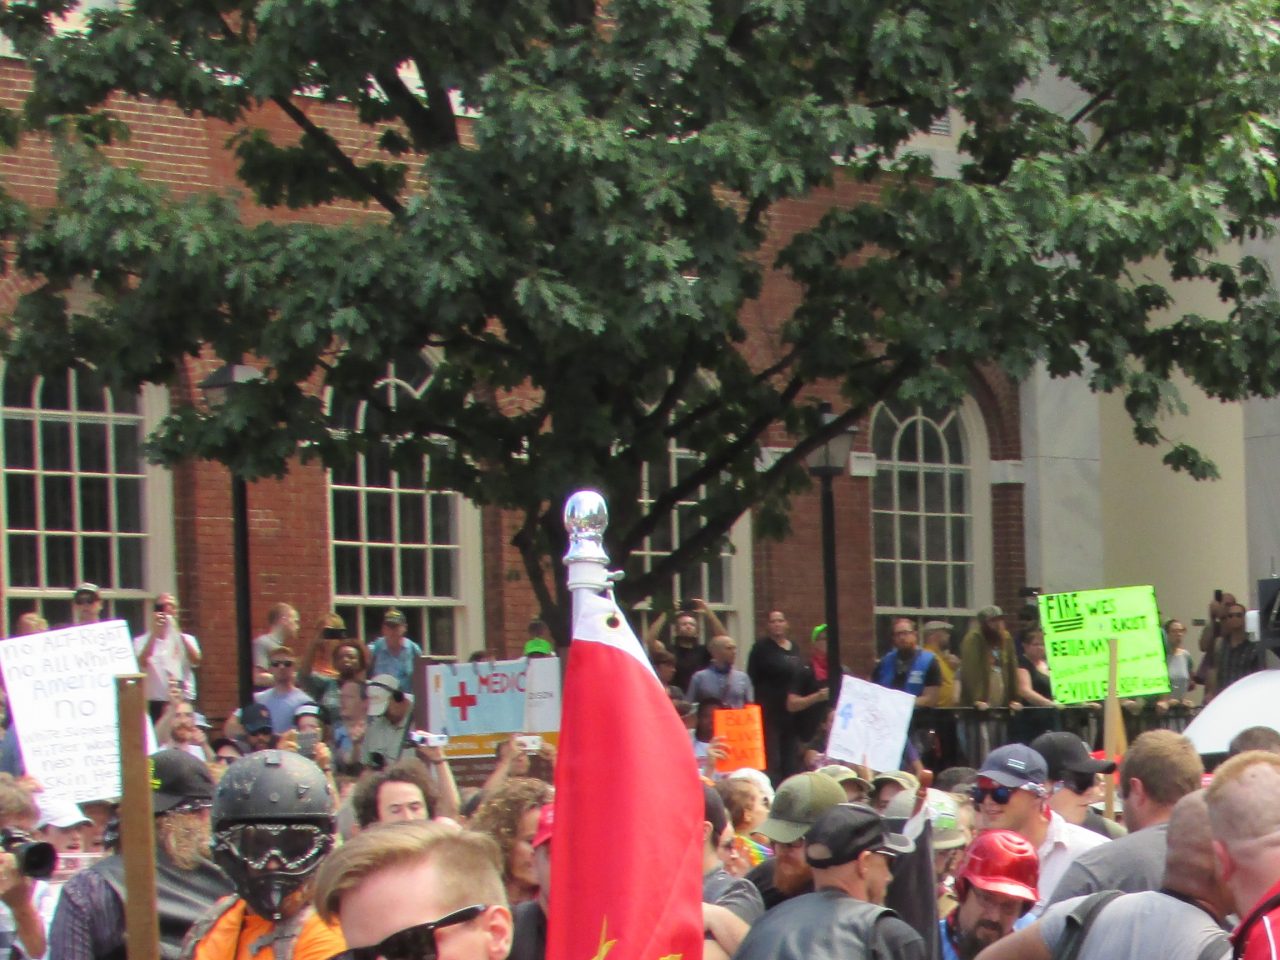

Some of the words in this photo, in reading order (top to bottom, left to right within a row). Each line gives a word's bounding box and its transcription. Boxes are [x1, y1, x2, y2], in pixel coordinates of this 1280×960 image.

[1046, 593, 1081, 620] FIRE
[1087, 599, 1115, 615] WES
[1112, 615, 1147, 632] RACIST
[33, 670, 112, 700] Americ
[477, 672, 527, 694] MEDIC
[55, 699, 96, 720] no
